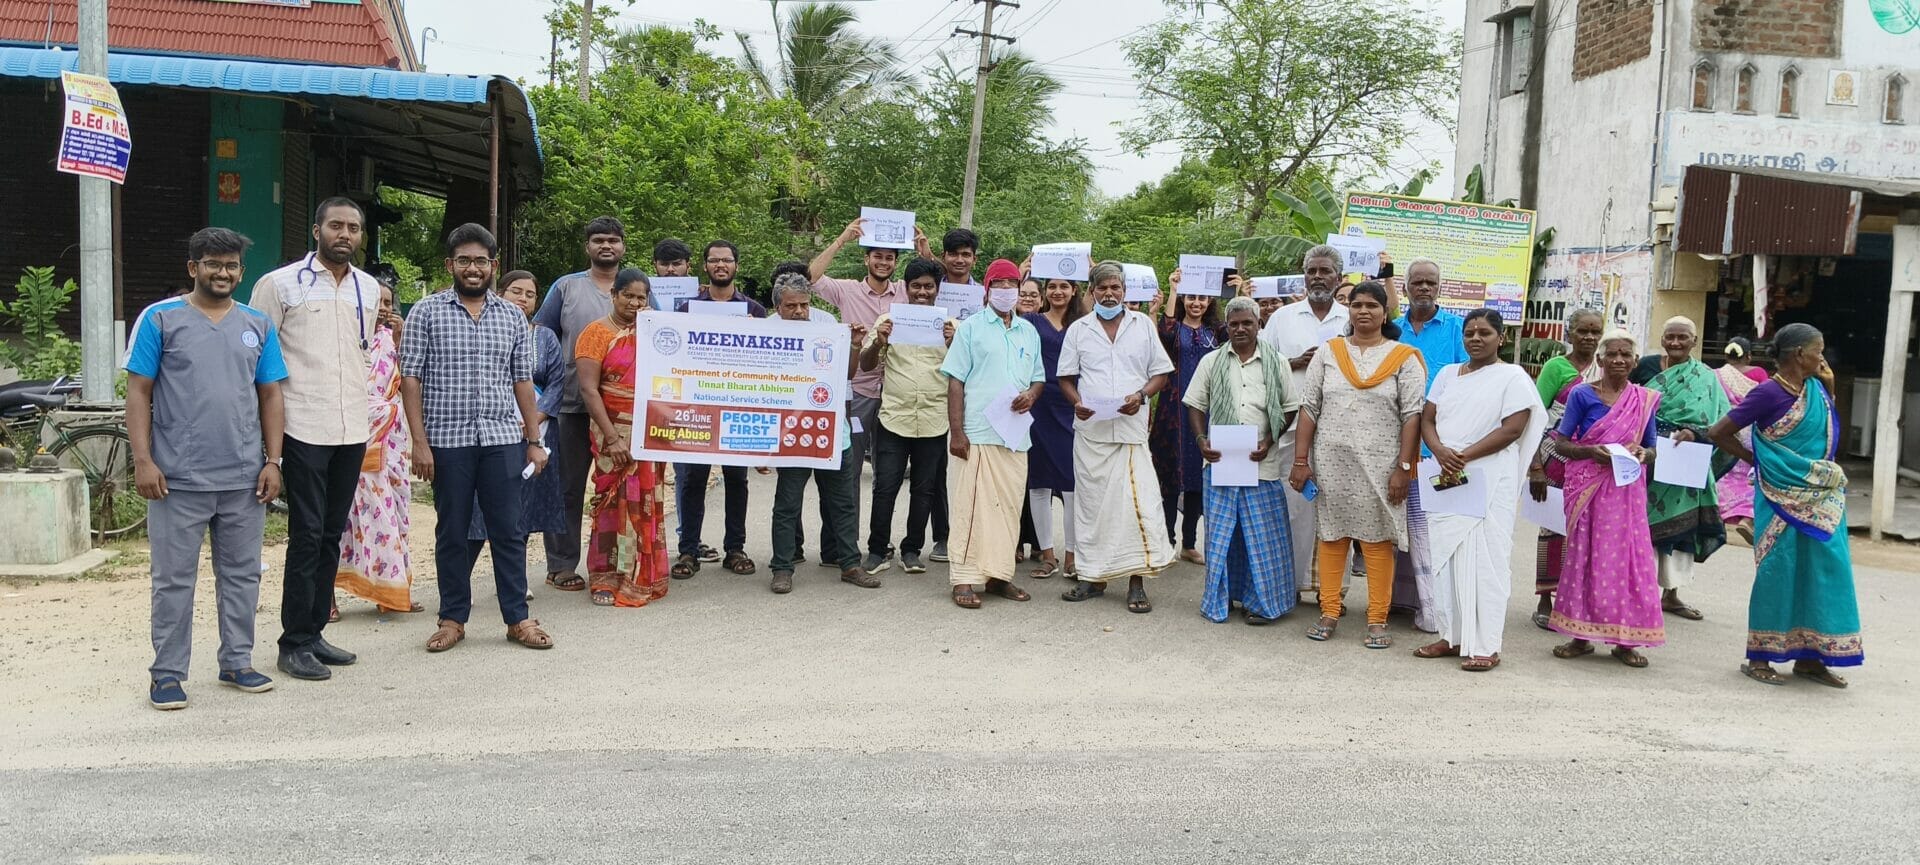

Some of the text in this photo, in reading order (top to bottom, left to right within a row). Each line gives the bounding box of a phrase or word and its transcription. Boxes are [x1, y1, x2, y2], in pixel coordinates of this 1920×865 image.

[72, 110, 103, 130] B.Ed
[687, 331, 804, 351] MEENAKSHI
[671, 367, 720, 377] Department
[732, 370, 779, 382] Community
[780, 374, 817, 382] Medicine
[698, 380, 795, 394] Unnat Bharat Abhiyan
[693, 393, 793, 405] National Service Scheme
[691, 414, 712, 423] JUNE
[722, 412, 777, 424] PEOPLE
[650, 425, 712, 440] Drug Abuse
[729, 424, 770, 436] FIRST
